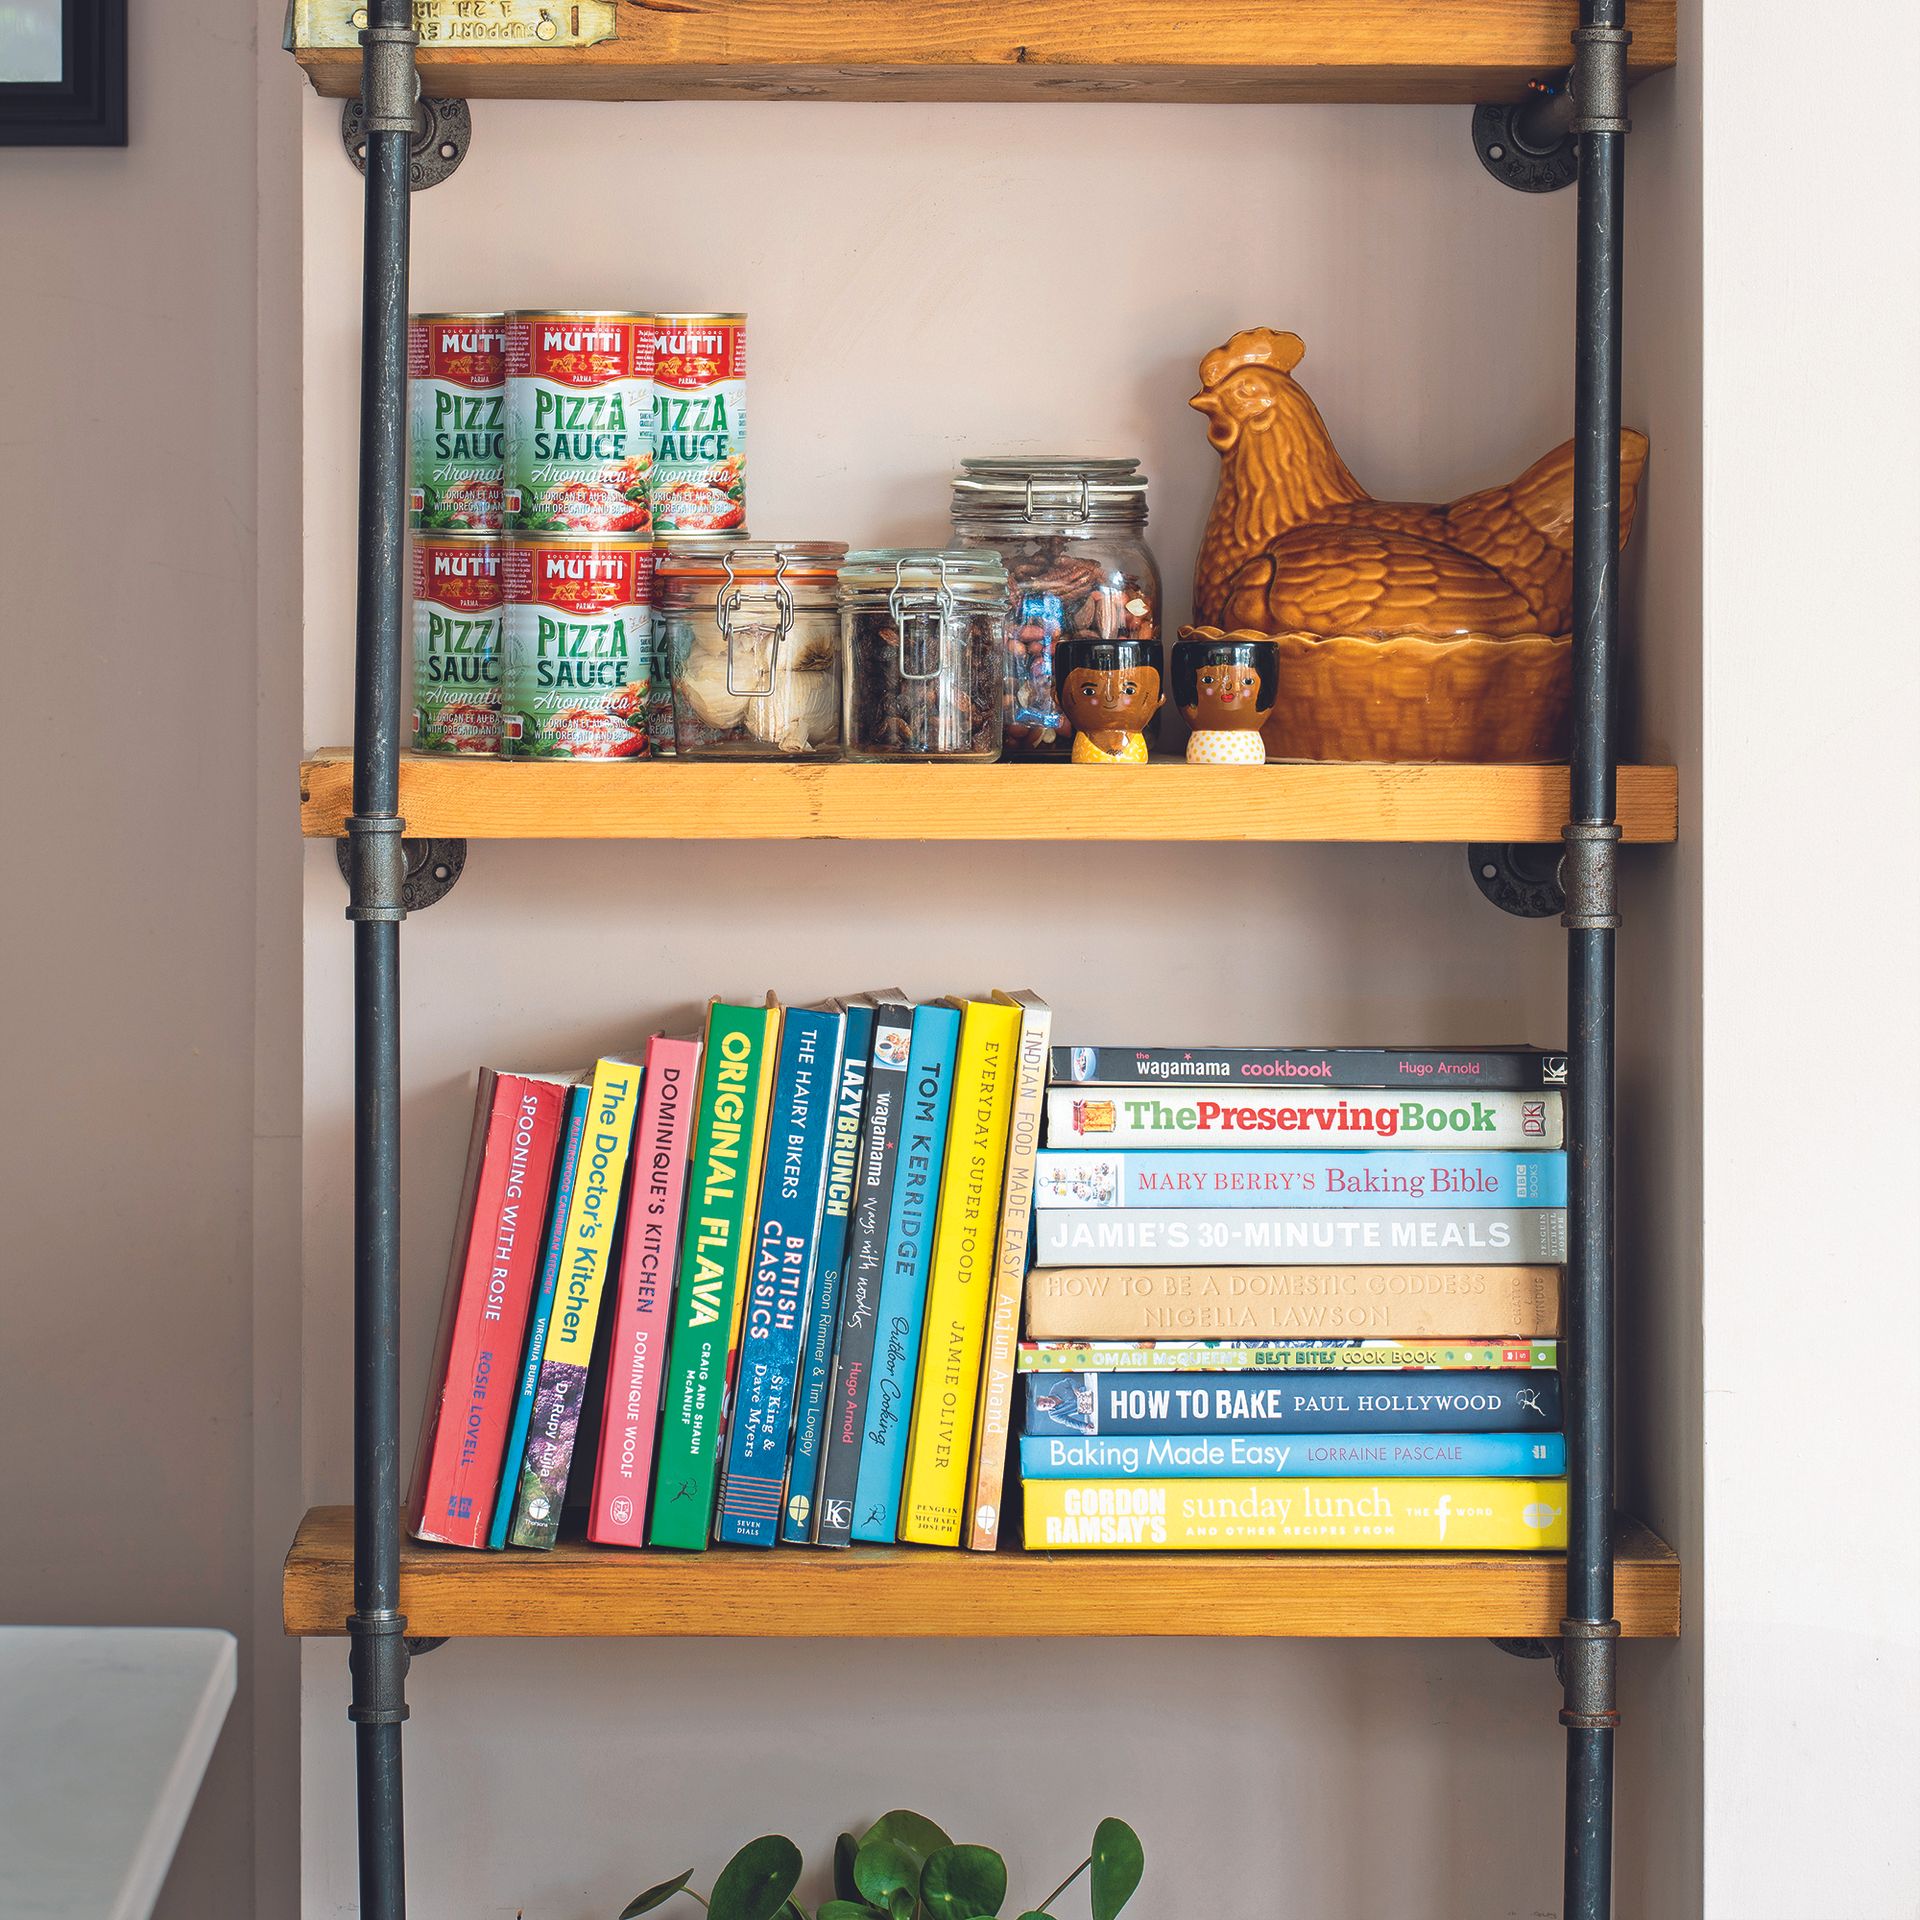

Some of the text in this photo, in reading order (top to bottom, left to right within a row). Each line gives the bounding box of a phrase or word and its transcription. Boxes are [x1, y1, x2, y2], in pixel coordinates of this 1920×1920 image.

[441, 334, 505, 353] MUTT
[543, 332, 622, 353] MUTTI
[470, 375, 490, 384] PARMA
[572, 375, 593, 384] PARMA
[678, 377, 698, 386] PARMA
[434, 388, 504, 431] PIZZ
[534, 387, 627, 432] PIZZA
[435, 433, 504, 462] SAUC
[534, 433, 627, 463] SAUCE
[532, 462, 629, 485] Aromatica
[532, 502, 551, 513] WITH
[541, 490, 576, 502] L'ORIGAN
[435, 557, 501, 577] MUTT
[546, 559, 623, 580] MUTTI
[460, 599, 479, 608] PARMA
[576, 602, 596, 611] PARMA
[428, 610, 502, 654] PIZZ
[537, 613, 628, 658] PIZZA
[429, 656, 500, 684] SAUC
[537, 659, 628, 688] SAUCE
[533, 690, 630, 711] Aromatica
[534, 730, 553, 740] WITH
[543, 718, 579, 729] L'ORIGAN
[1136, 1052, 1150, 1060] the
[1136, 1060, 1481, 1079] wagamama cookbook Hugo Arnold
[781, 1029, 819, 1200] THE HAIRY BIKERS
[1523, 1104, 1544, 1135] DK
[826, 1057, 867, 1218] LAZYBRUNCH
[866, 1091, 892, 1189] wagamama
[1001, 1028, 1044, 1280] INDIAN FOOD MADE EASY
[689, 1031, 752, 1328] ORIGINAL FLAVA
[895, 1062, 942, 1277] TOM KERRIDGE
[957, 1041, 1001, 1285] EVERYDAY SUPER FOOD
[636, 1067, 682, 1314] DOMINIQUE'S KITCHEN
[1138, 1166, 1499, 1198] MARY BERRY'S Baking Bible
[1516, 1164, 1527, 1198] BBC
[1529, 1163, 1539, 1198] BOOKS
[485, 1095, 538, 1322] SPOONING WITH ROSIE
[543, 1116, 582, 1295] WALKERSWOOD CARIBBEAN KITCHEN
[560, 1079, 629, 1344] The Doctor's Kitchen
[1050, 1221, 1511, 1248] JAMIE'S 30-MINUTE MEALS
[1550, 1212, 1558, 1257] MICHAEL
[858, 1240, 879, 1271] with
[750, 1220, 783, 1340] CLASSICS
[775, 1236, 805, 1330] BRITISH
[1045, 1273, 1488, 1298] HOW TO BE A DOMESTIC GODDESS
[847, 1276, 873, 1330] noodles
[1143, 1306, 1391, 1329] NIGELLA LAWSON
[523, 1317, 547, 1397] VIRGINIA BURKE
[799, 1269, 839, 1458] Simon Rimmer & Tim Lovejoy
[986, 1292, 1018, 1435] Anjum Anand
[1091, 1352, 1148, 1366] OMARI
[1254, 1351, 1290, 1365] BEST
[1295, 1351, 1337, 1365] BITES
[1341, 1350, 1386, 1365] COOK
[1391, 1350, 1438, 1364] BOOK
[681, 1369, 697, 1426] McANUFF
[868, 1315, 910, 1447] Outdoor Cooking
[935, 1320, 966, 1470] JAMIE OLIVER
[460, 1350, 494, 1468] ROSIE LOVELL
[620, 1331, 649, 1479] DOMINIQUE WOOLF
[690, 1342, 713, 1456] CRAIG AND SHAUN
[744, 1364, 768, 1459] Dave Myers
[761, 1375, 784, 1451] Si King &
[842, 1361, 863, 1446] Hugo Arnold
[1110, 1389, 1503, 1420] HOW TO BAKE PAUL HOLLYWOOD
[540, 1382, 569, 1479] Dr Rupy Aujla
[1050, 1438, 1463, 1473] Baking Made Easy LORRAINE PASCALE
[916, 1503, 959, 1515] PENGUIN
[1064, 1488, 1167, 1516] GORDON
[1181, 1486, 1394, 1525] sunday lunch
[1405, 1494, 1493, 1542] THE f WORD
[736, 1519, 761, 1529] SEVEN
[736, 1527, 760, 1537] DIALS
[913, 1514, 958, 1526] MICHAEL
[917, 1522, 954, 1533] JOSEPH
[1045, 1516, 1168, 1544] RAMSAY'S
[1186, 1525, 1396, 1537] AND OTHER RECIPES FROM
